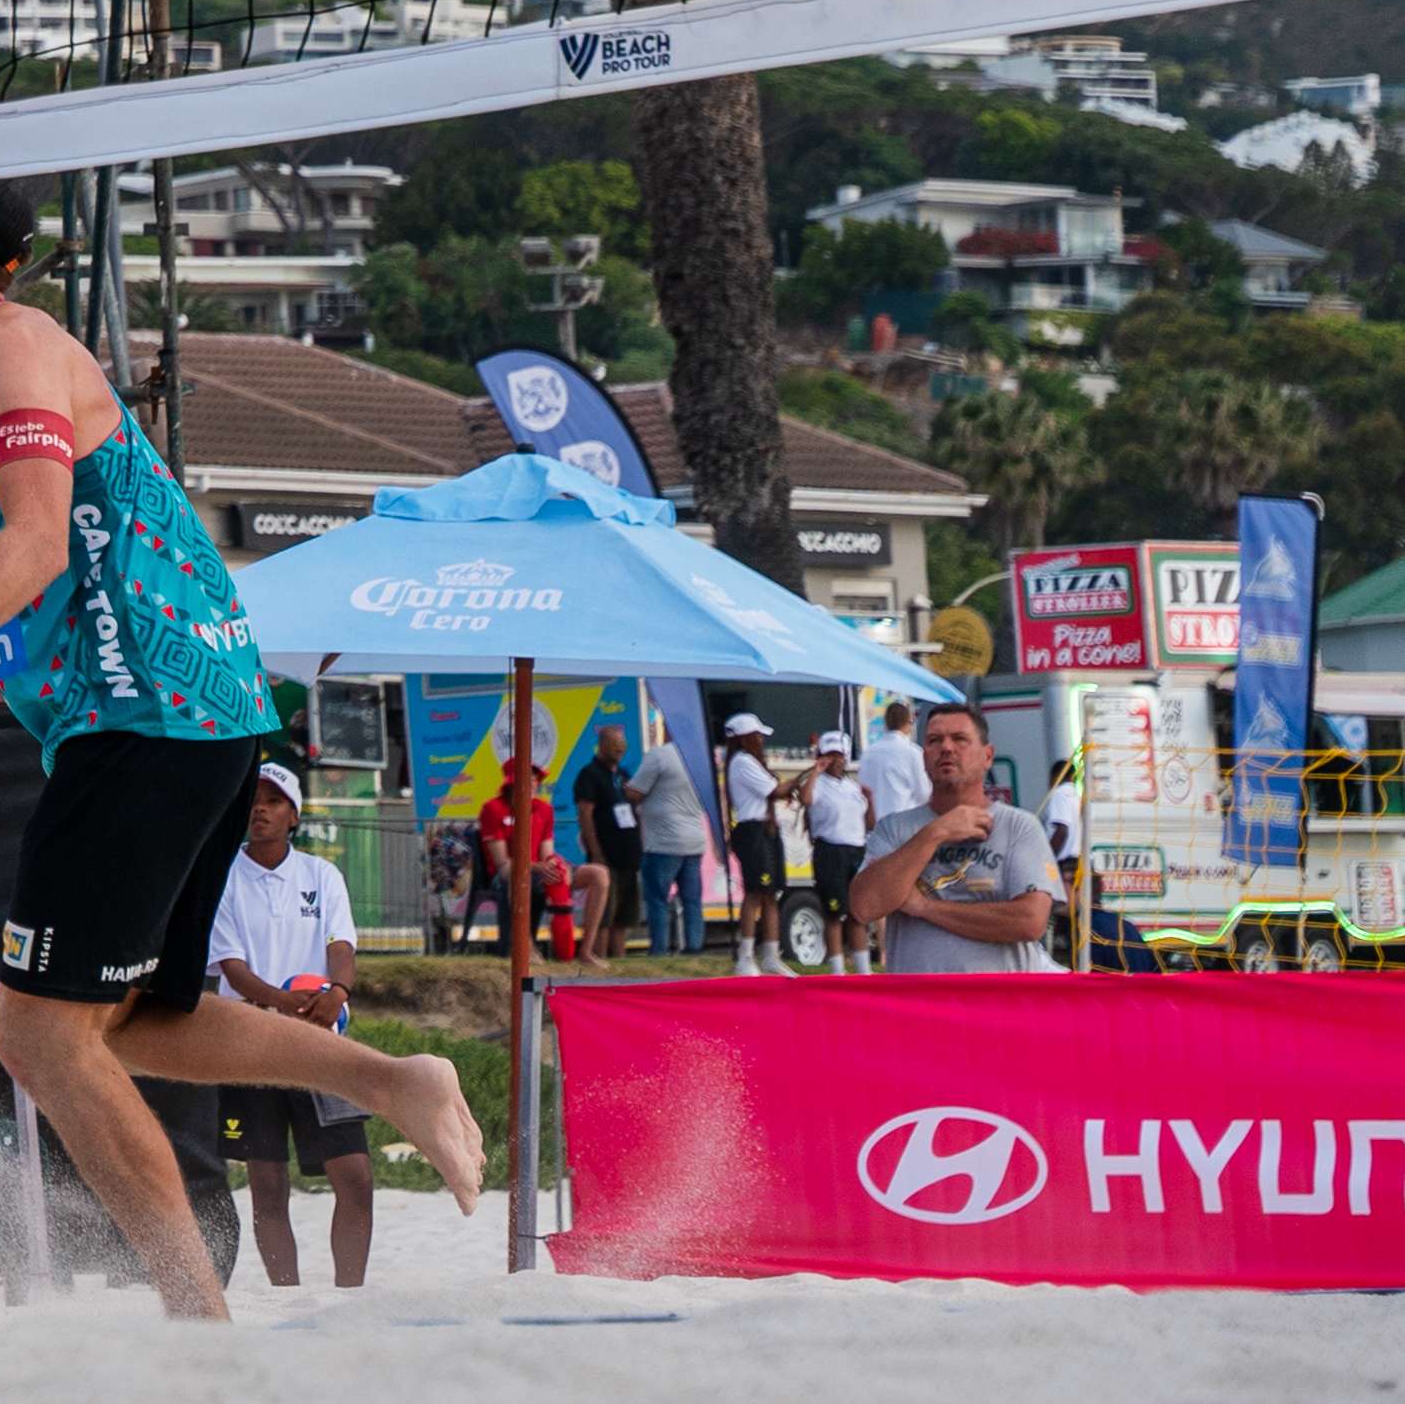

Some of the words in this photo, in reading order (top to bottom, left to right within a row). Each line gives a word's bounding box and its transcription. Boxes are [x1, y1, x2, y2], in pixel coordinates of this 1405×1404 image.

[601, 34, 670, 60] BEACH
[601, 60, 631, 75] PRO
[634, 53, 670, 70] TOUR
[5, 431, 73, 458] Fairplay
[350, 576, 563, 616] Corona
[1033, 574, 1122, 593] PIZZA
[410, 609, 492, 631] Cero
[86, 589, 140, 698] TOWN
[1053, 623, 1112, 649] Pizza
[1026, 644, 1050, 669] in
[38, 927, 54, 972] KIPSTA
